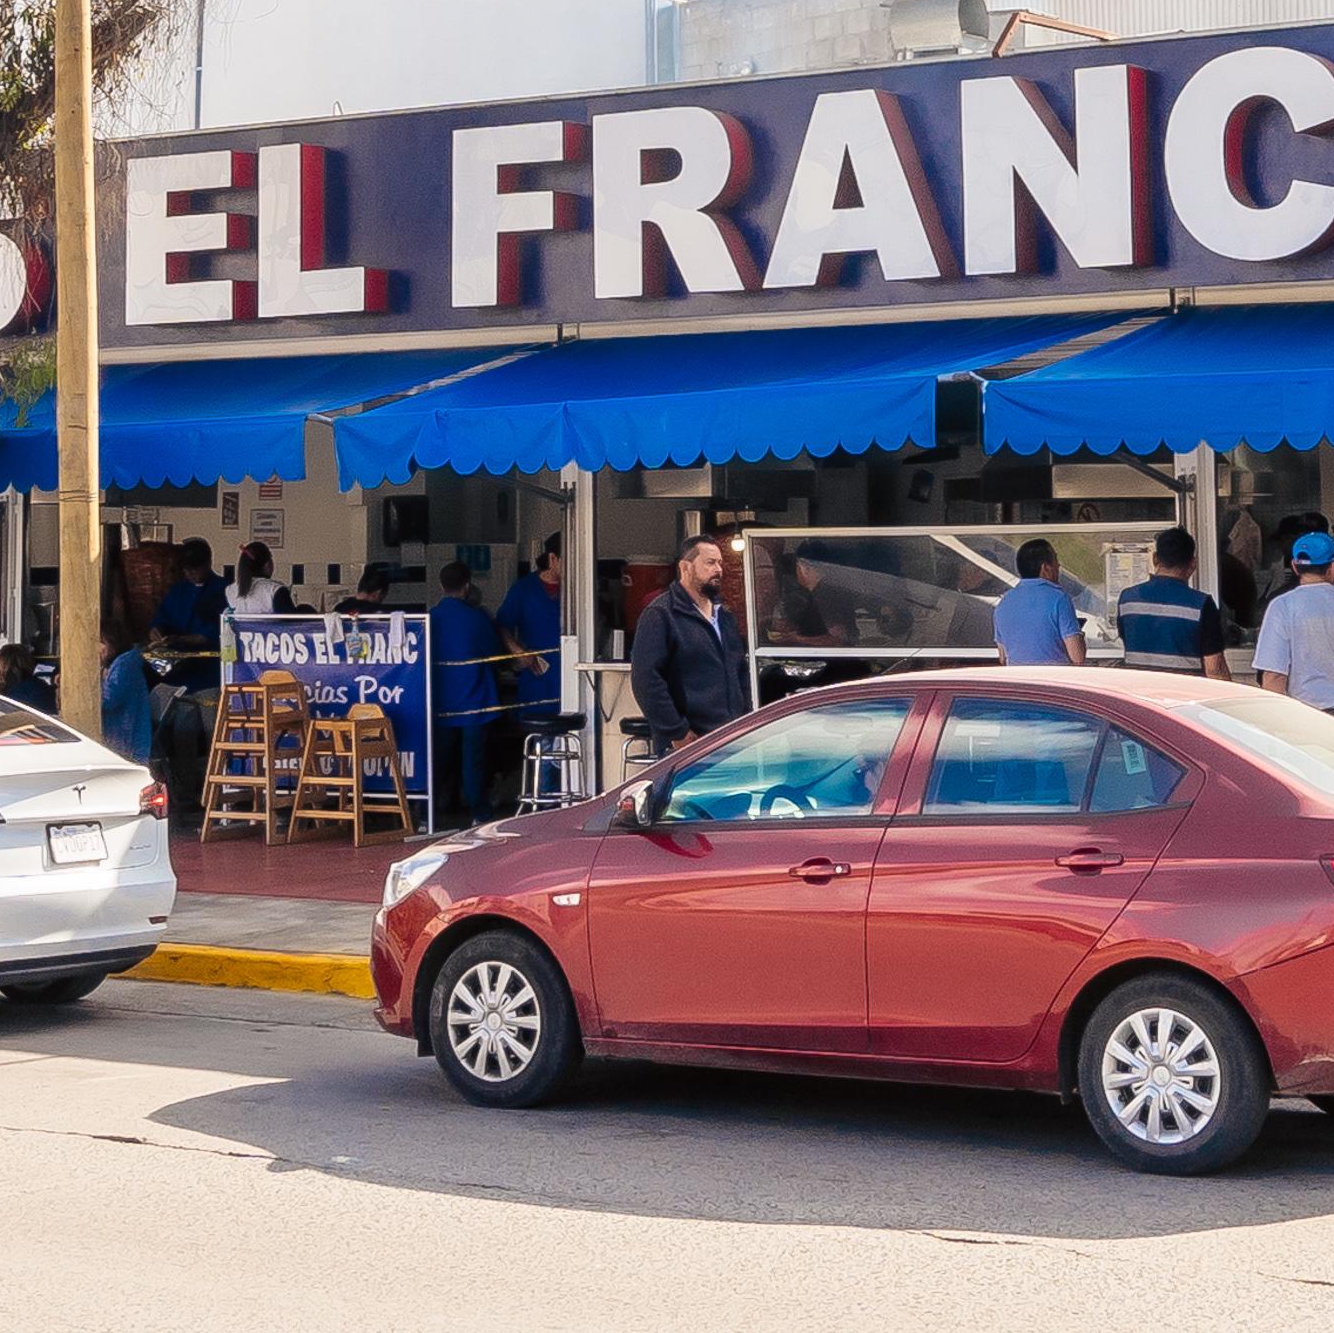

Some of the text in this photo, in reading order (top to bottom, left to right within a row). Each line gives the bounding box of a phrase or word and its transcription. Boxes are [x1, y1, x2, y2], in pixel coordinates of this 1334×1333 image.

[125, 143, 367, 326] EL
[239, 631, 310, 665] TACOS
[312, 631, 341, 665] EL
[353, 674, 406, 705] Por
